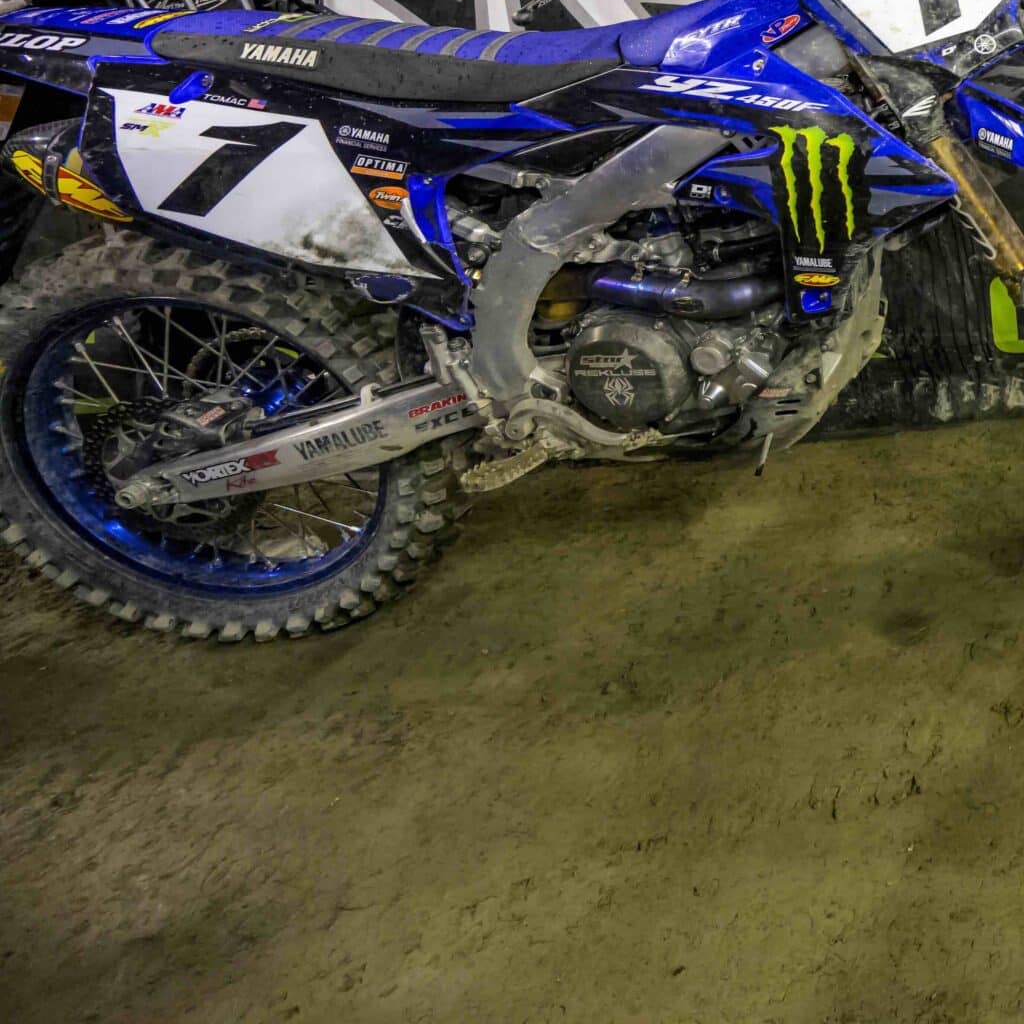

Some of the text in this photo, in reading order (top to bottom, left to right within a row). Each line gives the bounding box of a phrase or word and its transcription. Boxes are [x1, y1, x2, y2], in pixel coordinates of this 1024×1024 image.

[240, 42, 318, 68] YAMAHA
[202, 93, 247, 106] TOMAC
[350, 127, 390, 144] YAMAHA
[986, 130, 1013, 151] YAMAHA
[357, 156, 404, 173] OPTIMA
[794, 256, 833, 268] YAMALUBE
[408, 393, 467, 417] BRAKIN
[293, 421, 389, 462] YAMALUBE
[182, 458, 252, 485] VORTEX
